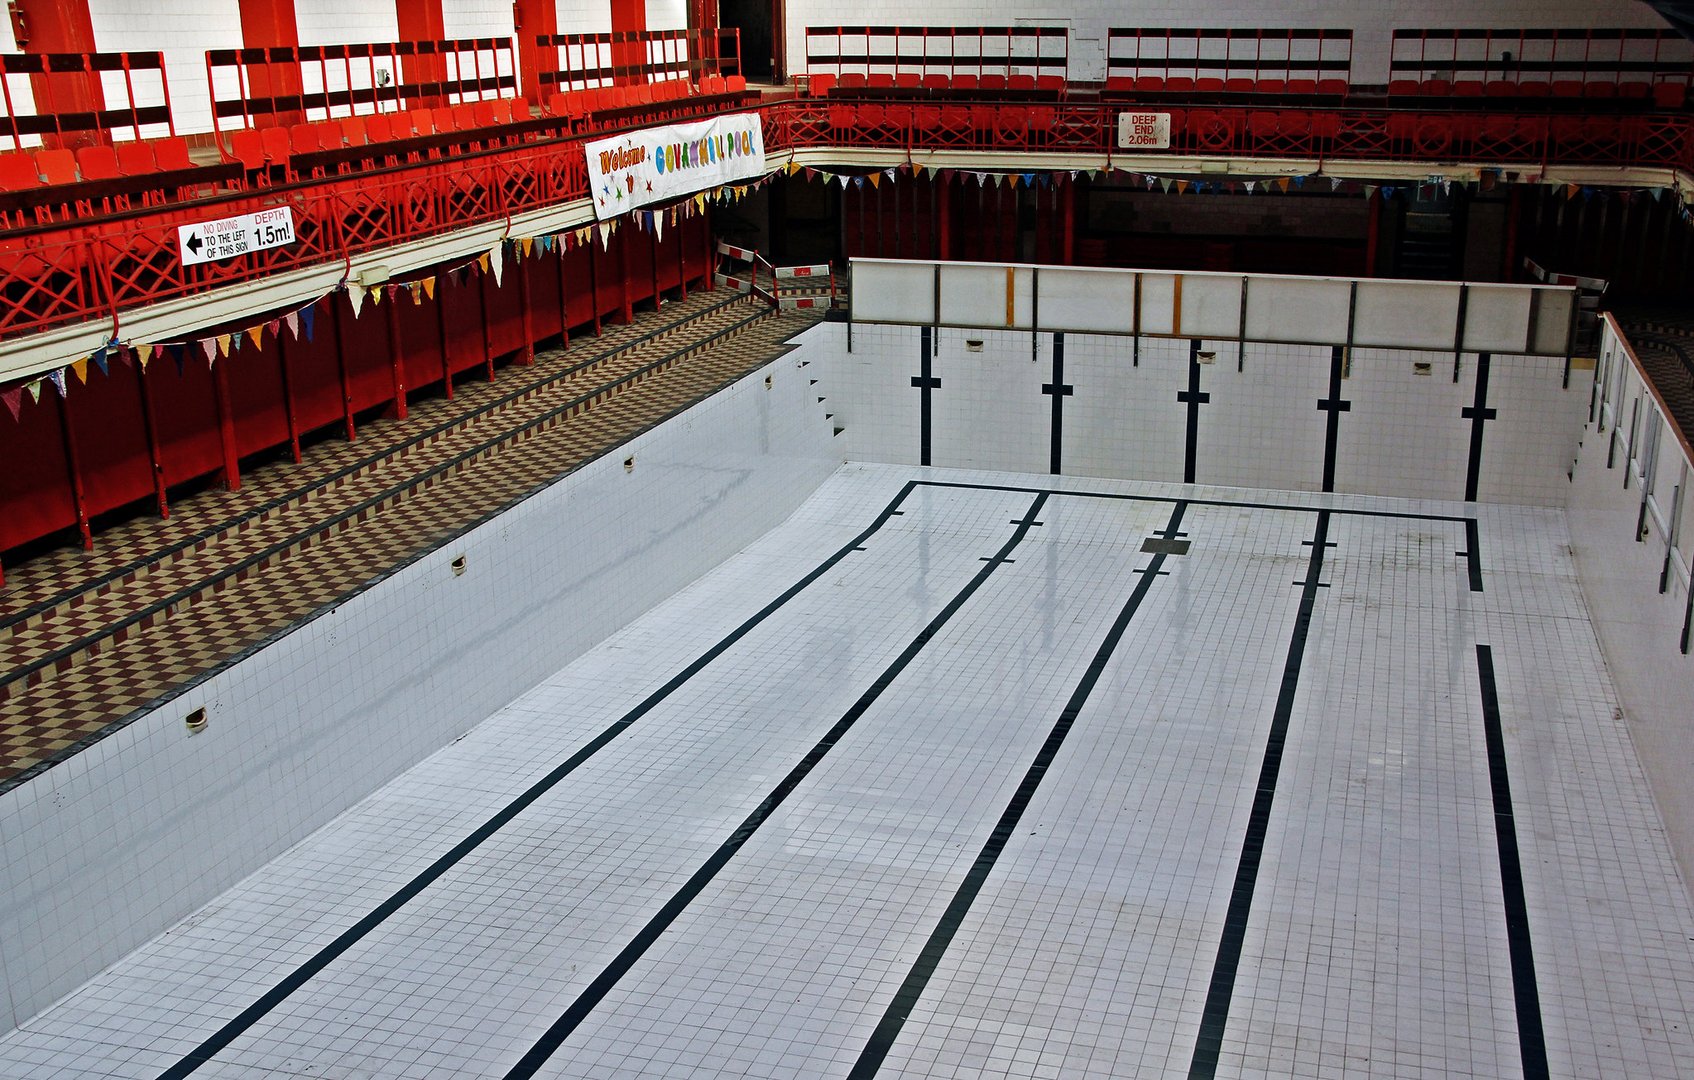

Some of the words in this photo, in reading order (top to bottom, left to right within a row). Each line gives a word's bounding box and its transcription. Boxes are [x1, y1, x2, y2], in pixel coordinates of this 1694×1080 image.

[1132, 115, 1156, 124] DEEP
[1134, 125, 1154, 134] END
[1128, 135, 1157, 145] 2.06m
[599, 145, 646, 175] Welcome
[655, 134, 725, 175] GOVANHILL
[727, 130, 756, 160] POOL
[254, 209, 286, 225] DEPTH
[203, 224, 215, 235] NO
[217, 220, 239, 233] DIVING
[254, 222, 291, 246] 1.5m!
[205, 236, 216, 246] TO
[218, 233, 232, 244] THE
[232, 230, 246, 242] LEFT
[207, 247, 216, 259] OF
[220, 244, 235, 256] THIS
[235, 241, 249, 253] SIGN
